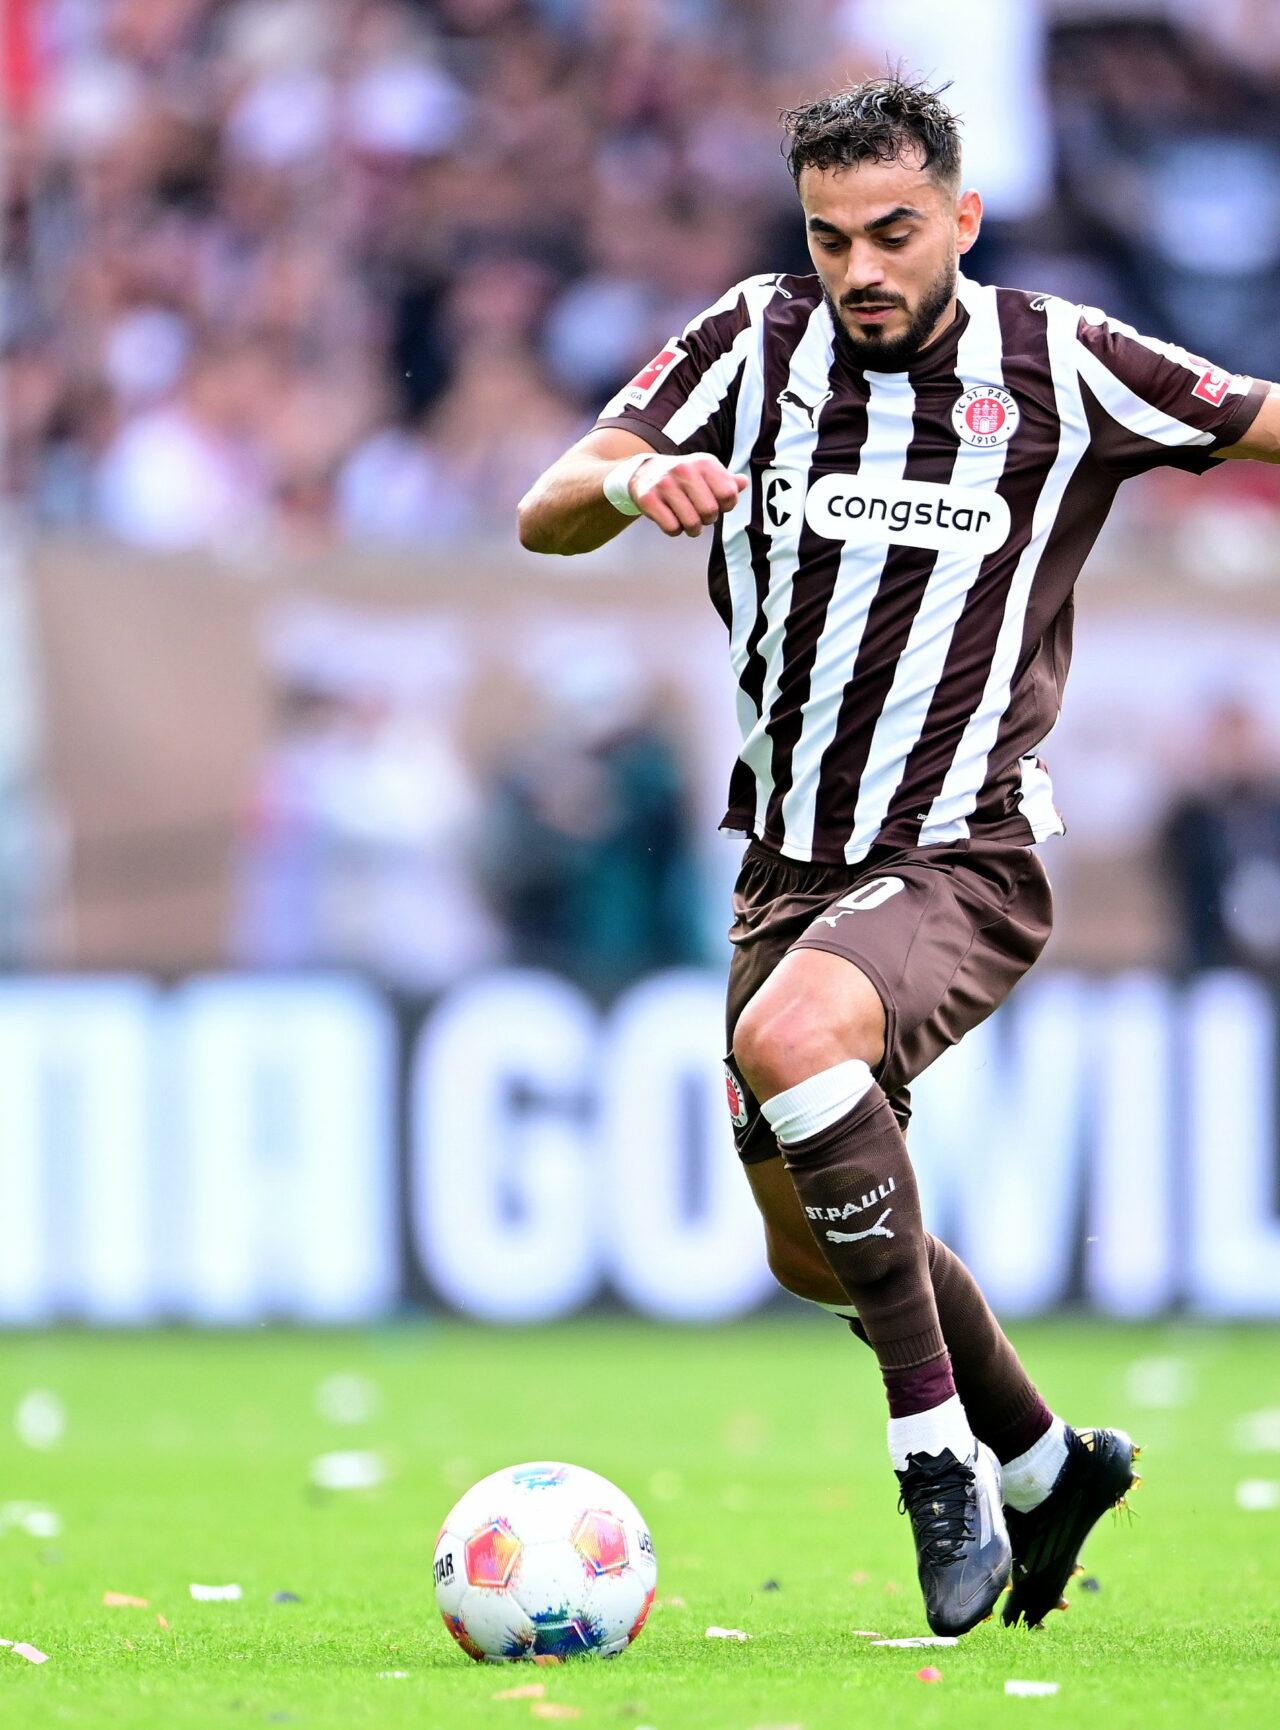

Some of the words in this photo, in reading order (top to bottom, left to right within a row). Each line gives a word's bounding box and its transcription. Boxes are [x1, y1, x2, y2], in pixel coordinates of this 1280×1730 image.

[955, 403, 966, 414] FC
[987, 389, 1016, 415] PAULI
[971, 435, 997, 445] 1910
[828, 495, 991, 532] congstar
[836, 876, 905, 910] 0
[408, 968, 780, 1323] GO
[805, 1177, 896, 1222] ST.PAULI
